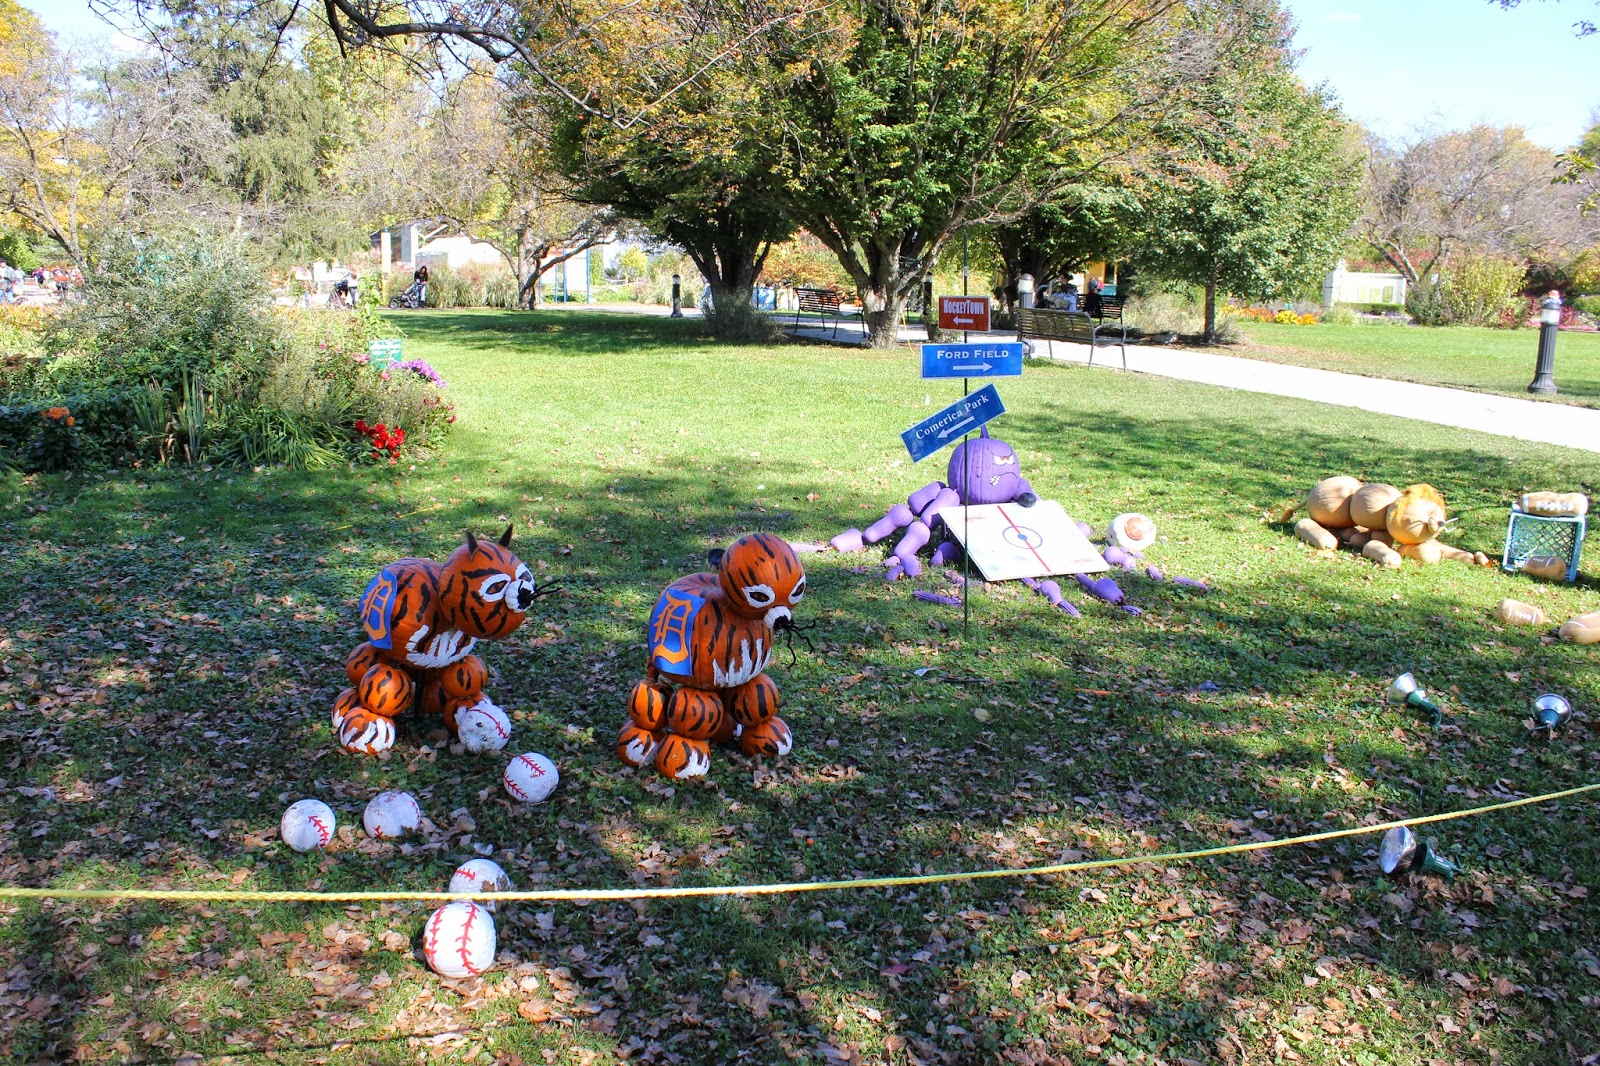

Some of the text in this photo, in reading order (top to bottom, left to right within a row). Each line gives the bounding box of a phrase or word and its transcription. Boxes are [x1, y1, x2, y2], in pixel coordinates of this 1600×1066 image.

[937, 349, 1009, 359] FORD FIELD
[916, 394, 989, 440] Comerica Park
[360, 572, 393, 641] D
[652, 591, 693, 665] D
